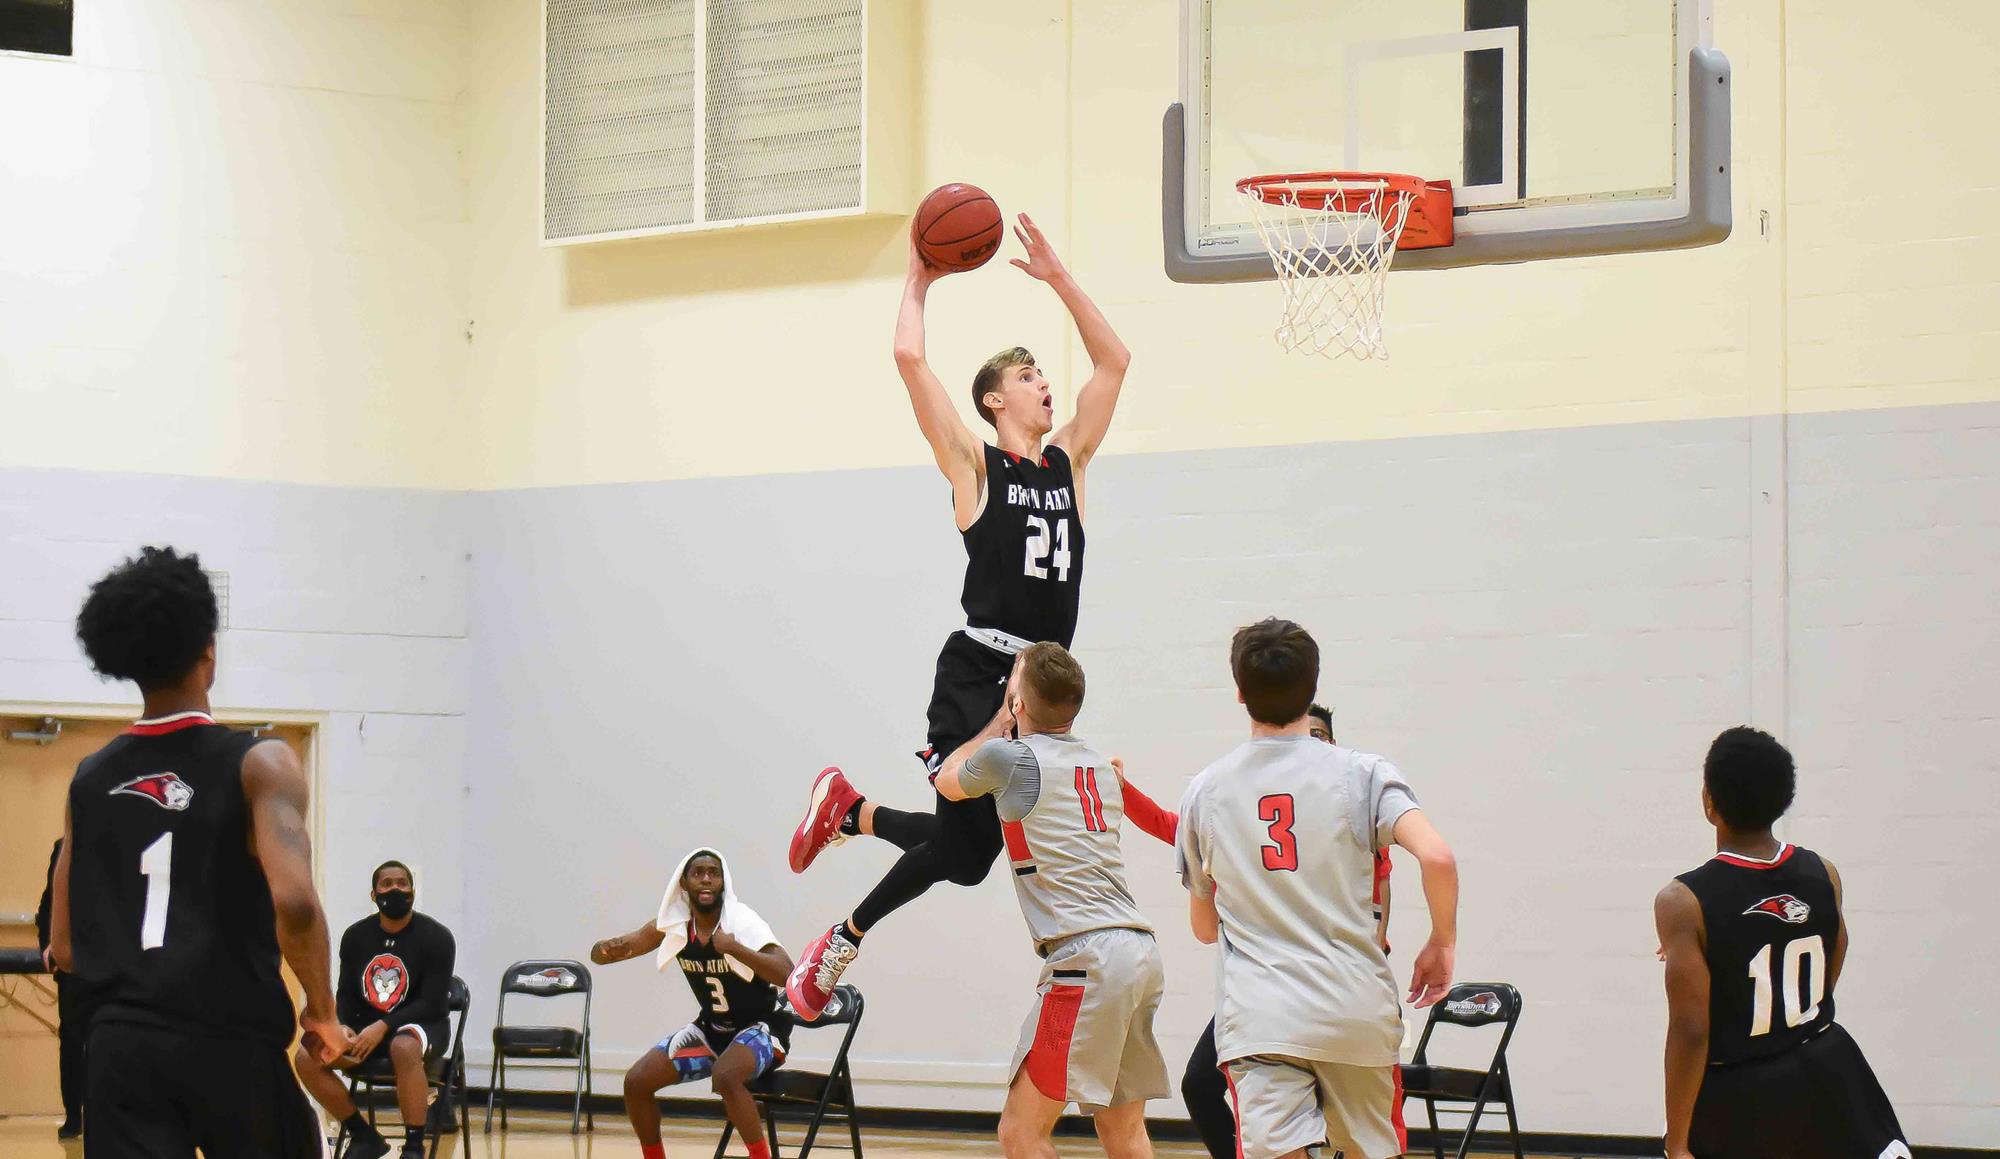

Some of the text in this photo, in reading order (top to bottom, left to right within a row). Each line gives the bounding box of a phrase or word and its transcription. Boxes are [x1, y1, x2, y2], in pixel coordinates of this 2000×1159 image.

[1024, 514, 1071, 582] 24
[1074, 765, 1108, 833] 11
[1258, 793, 1298, 872] 3
[140, 831, 173, 951] 1
[705, 976, 730, 1013] 3
[707, 959, 730, 973] ATHY
[1748, 934, 1826, 1037] 10
